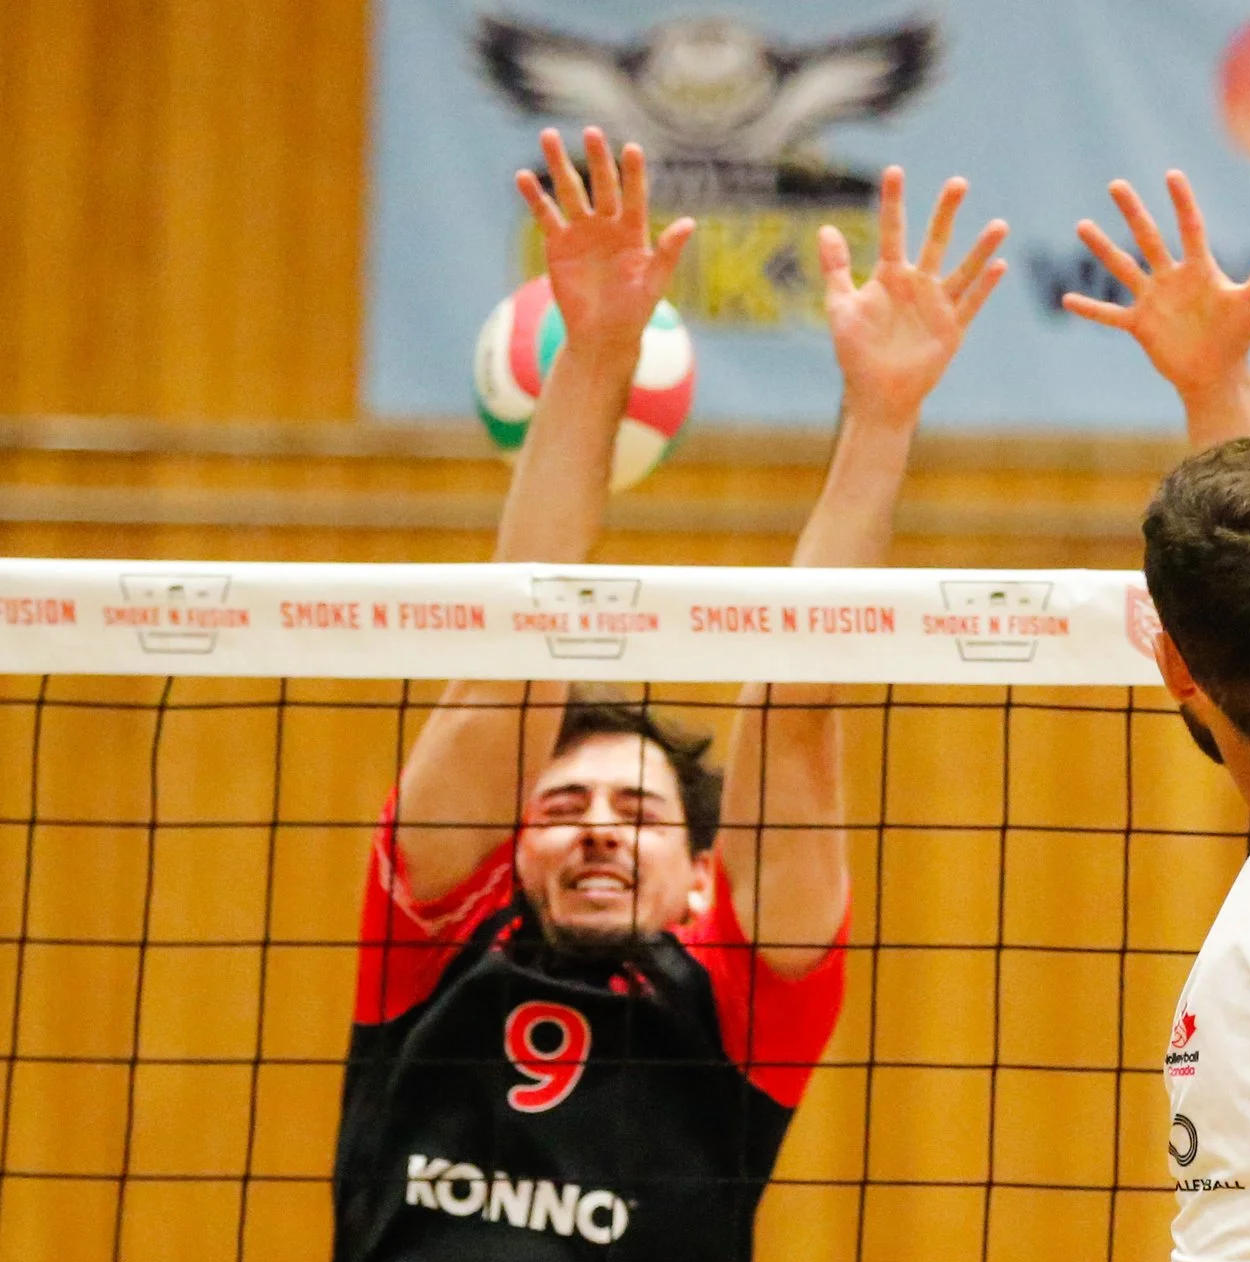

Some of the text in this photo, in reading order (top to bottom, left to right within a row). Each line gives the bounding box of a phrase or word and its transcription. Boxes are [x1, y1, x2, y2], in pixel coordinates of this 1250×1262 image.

[0, 596, 76, 625] USION
[280, 600, 486, 631] SMOKE N FUSION
[690, 605, 895, 634] SMOKE N FUSION
[923, 615, 1070, 636] SMOKE N FUSION
[504, 1000, 592, 1113] 9
[405, 1154, 629, 1245] KONNO
[1175, 1178, 1246, 1192] LLEYBALL
